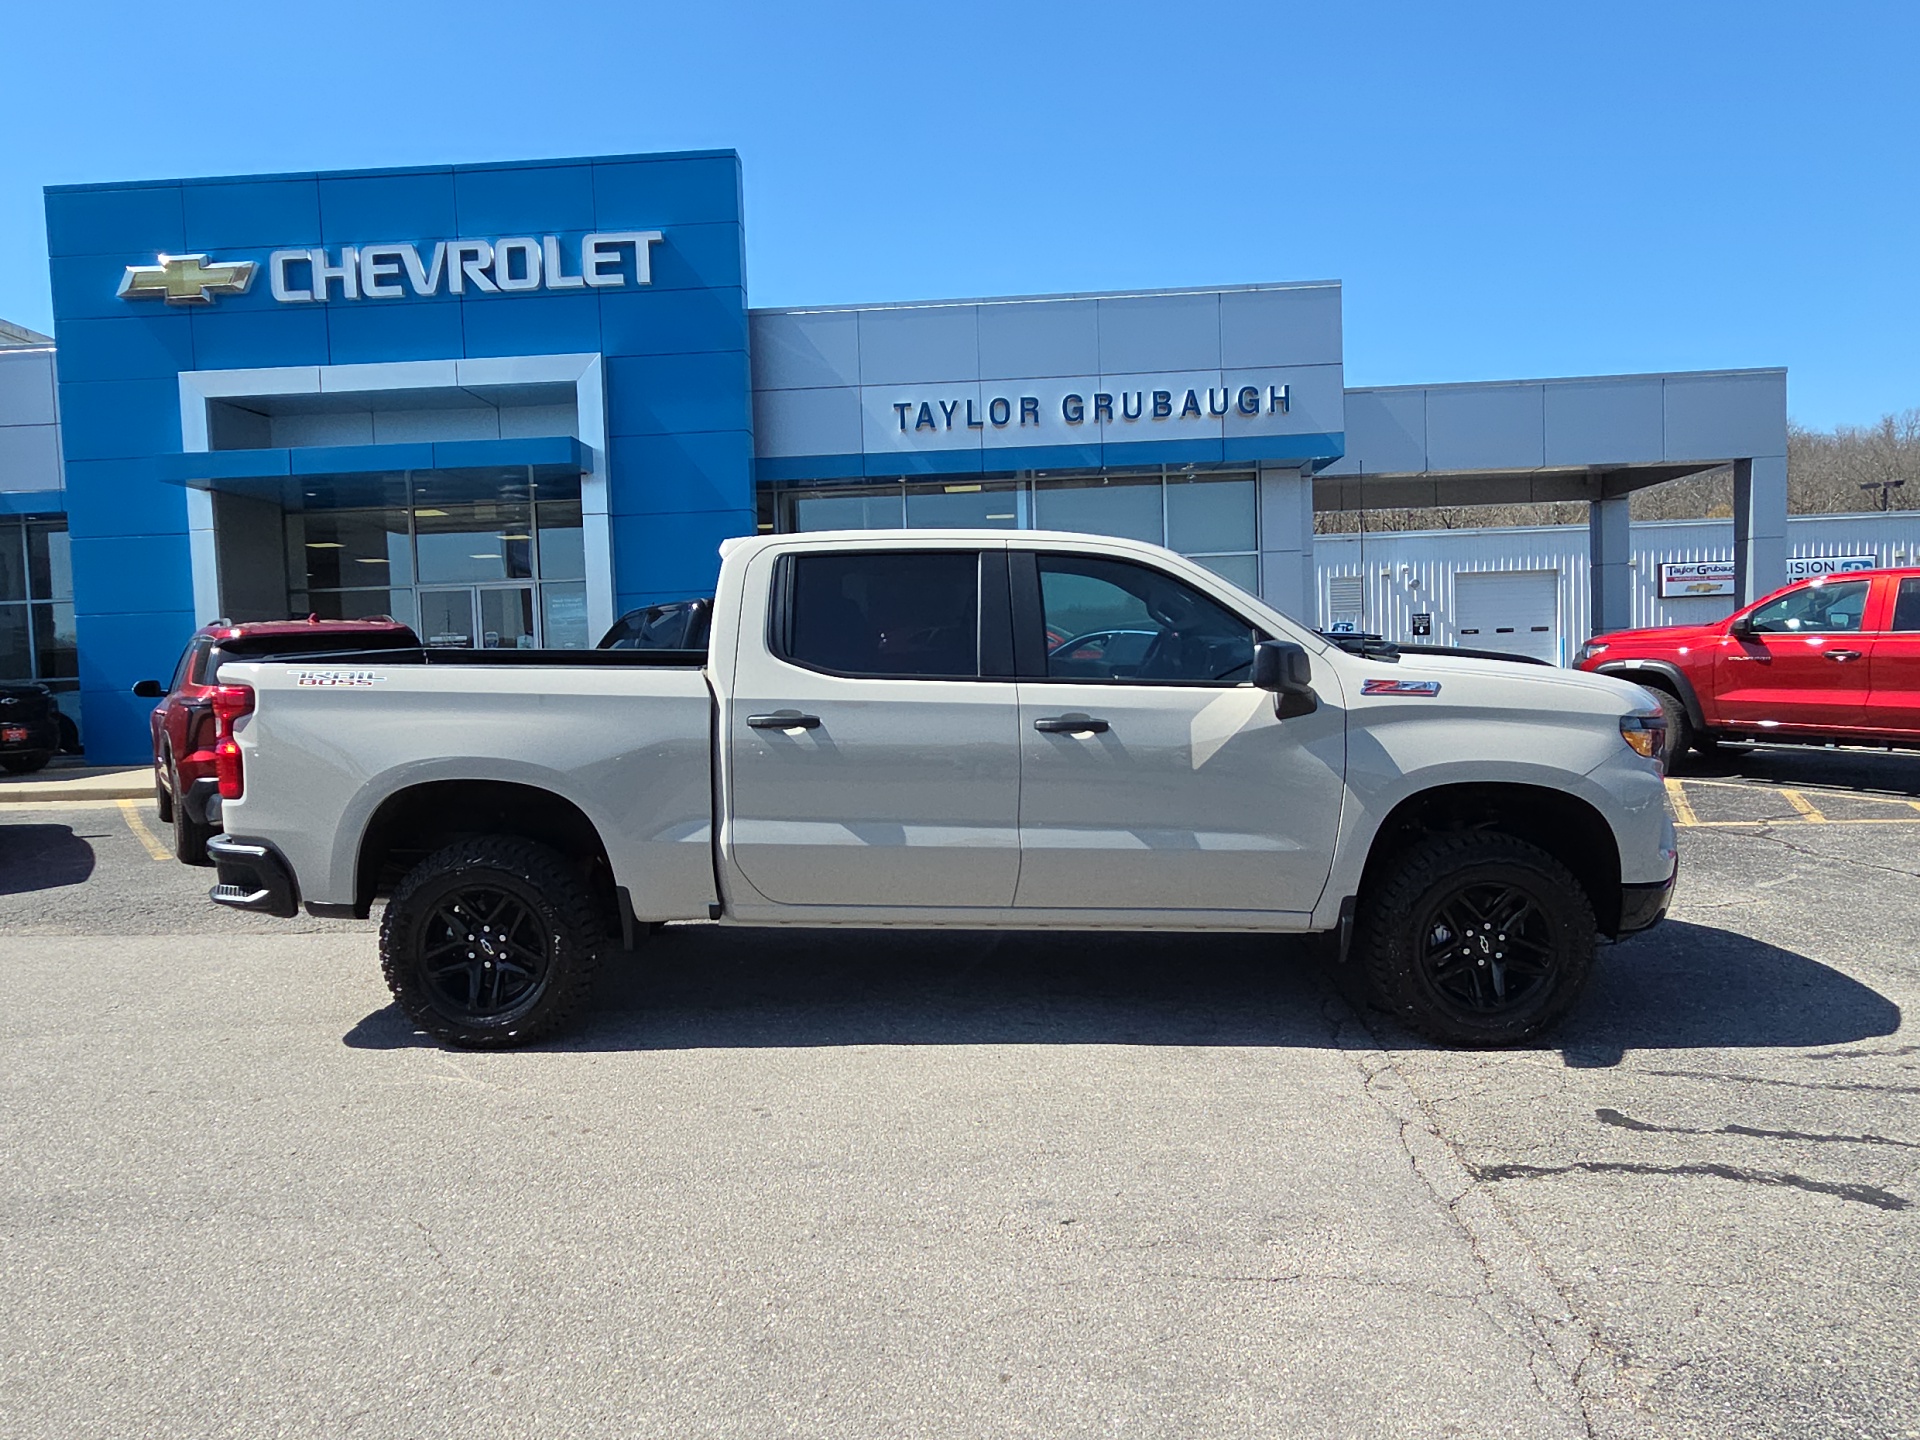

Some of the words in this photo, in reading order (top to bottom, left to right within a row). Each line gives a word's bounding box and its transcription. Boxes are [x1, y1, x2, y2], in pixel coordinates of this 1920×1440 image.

[269, 231, 663, 302] CHEVROLET
[893, 396, 1040, 431] TAYLOR
[1062, 384, 1291, 424] GRUBAUGH
[1666, 565, 1696, 576] Taylor
[287, 670, 387, 680] TRAIL
[1360, 679, 1442, 697] Z71
